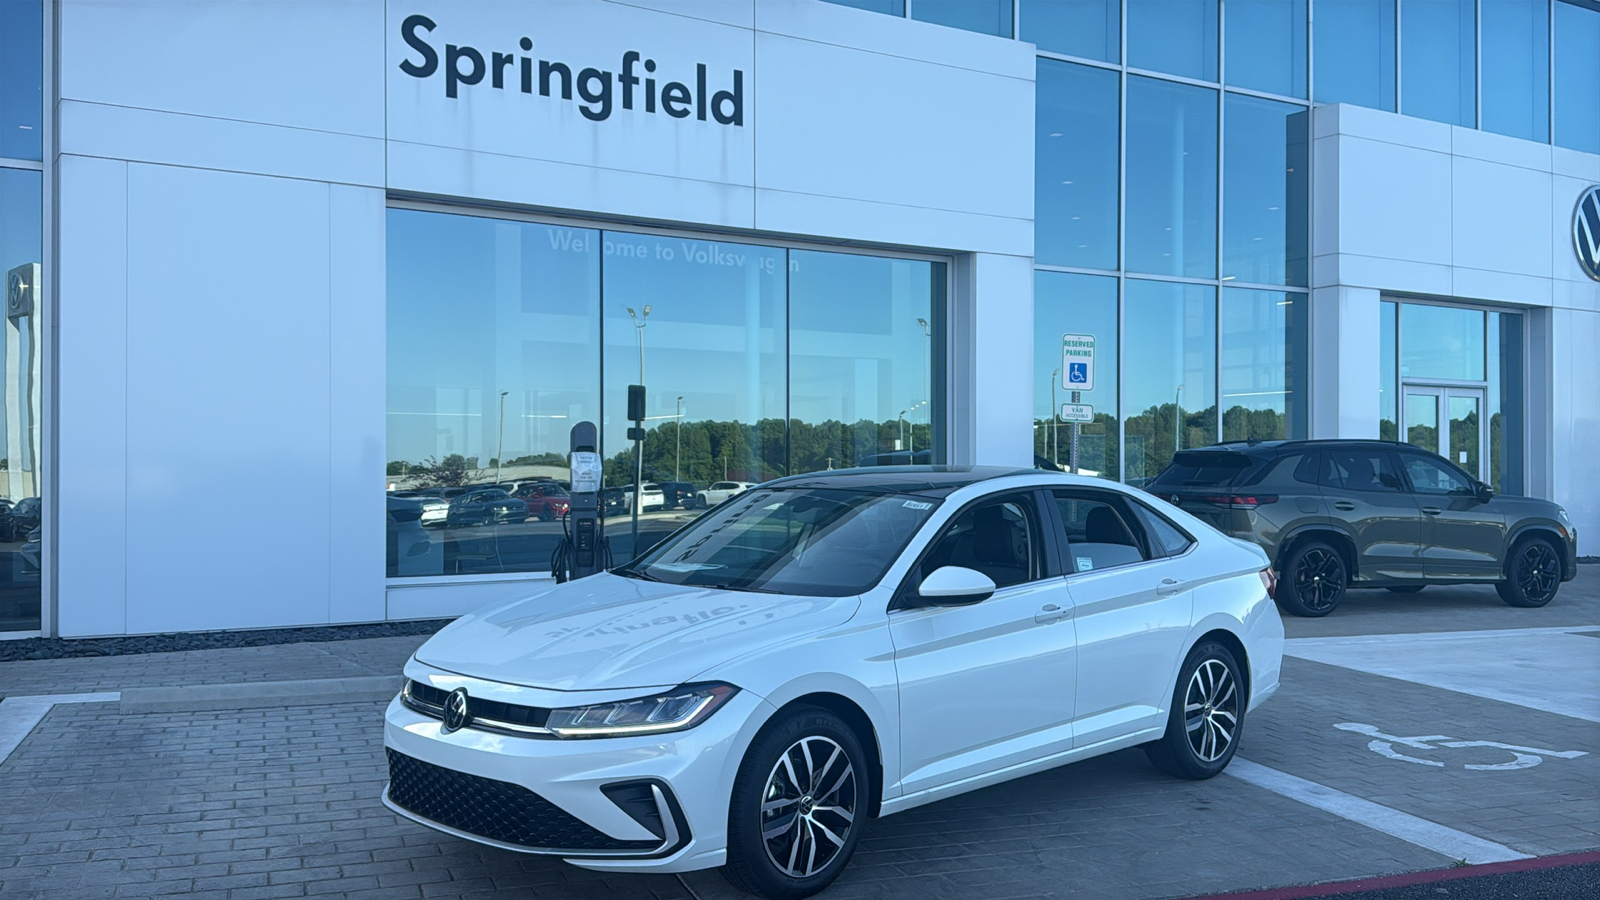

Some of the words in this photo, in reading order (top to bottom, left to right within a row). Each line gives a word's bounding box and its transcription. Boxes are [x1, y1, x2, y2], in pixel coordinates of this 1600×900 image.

[399, 14, 744, 127] Springfield
[547, 228, 649, 259] Welome
[655, 242, 675, 261] to
[1064, 340, 1094, 348] RESERVED
[1065, 349, 1092, 357] PARKING
